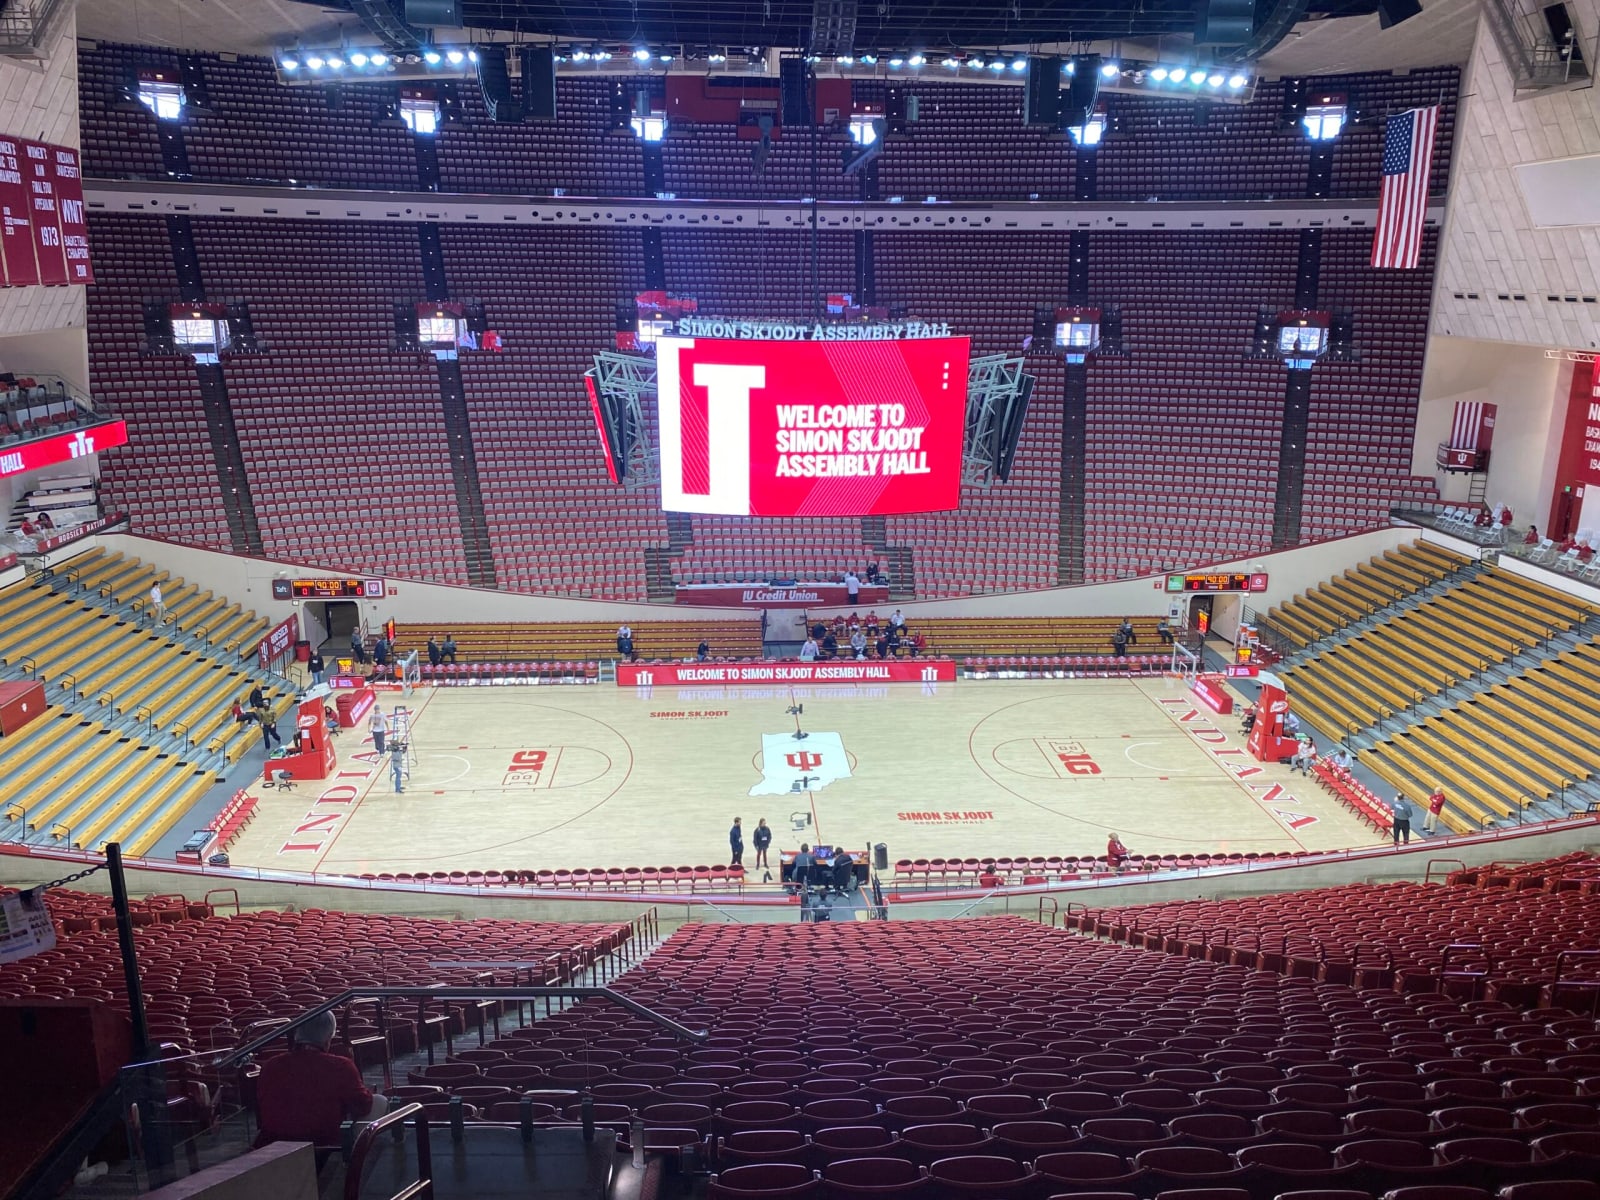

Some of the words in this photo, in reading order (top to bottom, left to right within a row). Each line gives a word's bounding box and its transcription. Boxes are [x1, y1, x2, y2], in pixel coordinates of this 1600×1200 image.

[679, 318, 737, 338] SIMON
[740, 322, 807, 340] SKJODT
[811, 323, 903, 340] ASSEMBLY
[904, 322, 951, 338] HALL
[776, 403, 875, 428] WELCOME
[878, 403, 905, 426] TO
[776, 429, 844, 453] SIMON
[847, 427, 925, 451] SKJODT
[0, 452, 25, 474] HALL
[776, 453, 882, 478] ASSEMBLY
[882, 451, 931, 474] HALL
[58, 527, 83, 543] HOOSIER
[86, 518, 106, 532] NATION
[743, 590, 754, 600] IU
[756, 589, 787, 600] Credit
[788, 589, 817, 600] Union
[677, 668, 725, 681] WELCOME
[727, 668, 739, 680] TO
[741, 668, 773, 680] SIMON
[775, 667, 813, 679] SKJODT
[814, 667, 864, 679] ASSEMBLY
[866, 666, 890, 678] HALL
[1157, 698, 1319, 830] INDIANA
[897, 811, 941, 821] SIMON
[943, 811, 994, 820] SKJODT
